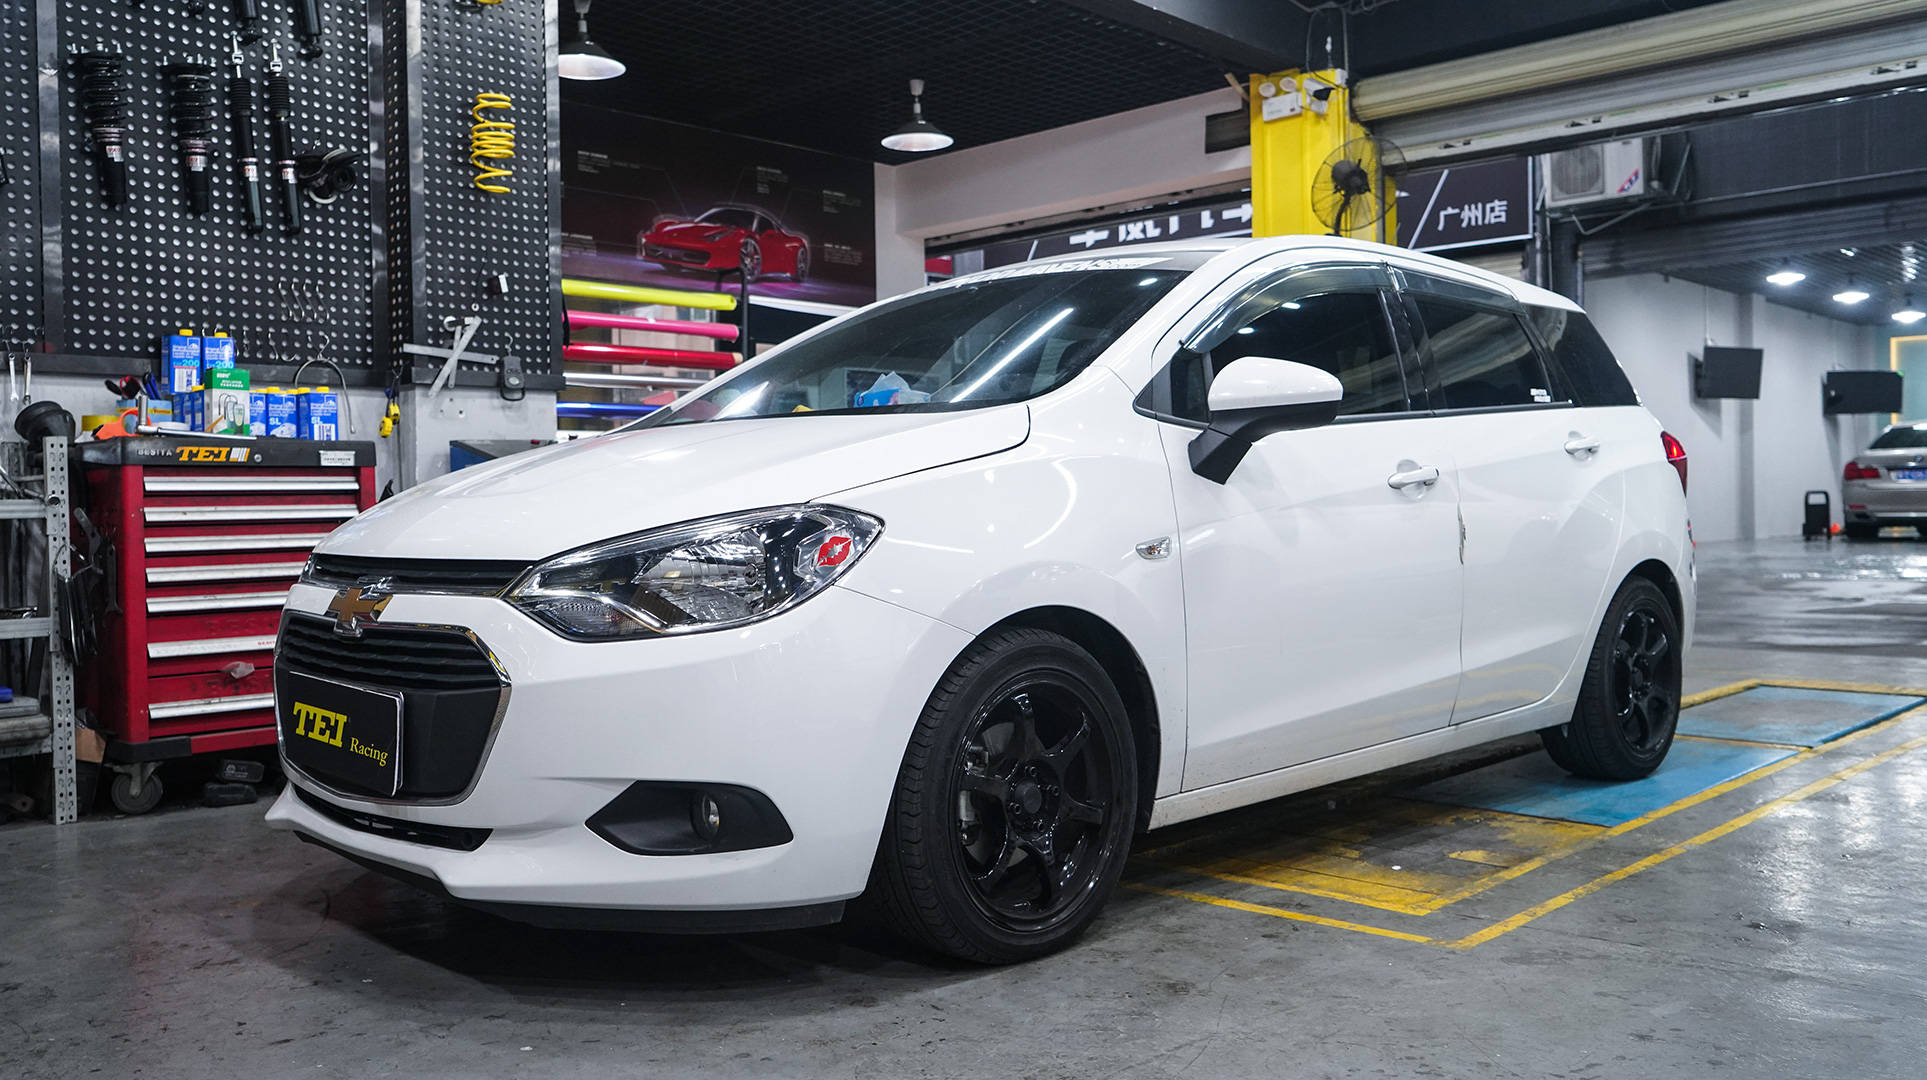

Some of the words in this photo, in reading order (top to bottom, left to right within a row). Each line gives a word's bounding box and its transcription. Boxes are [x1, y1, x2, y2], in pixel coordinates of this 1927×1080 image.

[1438, 200, 1507, 231] 广州店
[182, 359, 200, 367] 200
[176, 446, 230, 462] TEI
[293, 702, 347, 747] TEI
[350, 737, 388, 767] Racing
